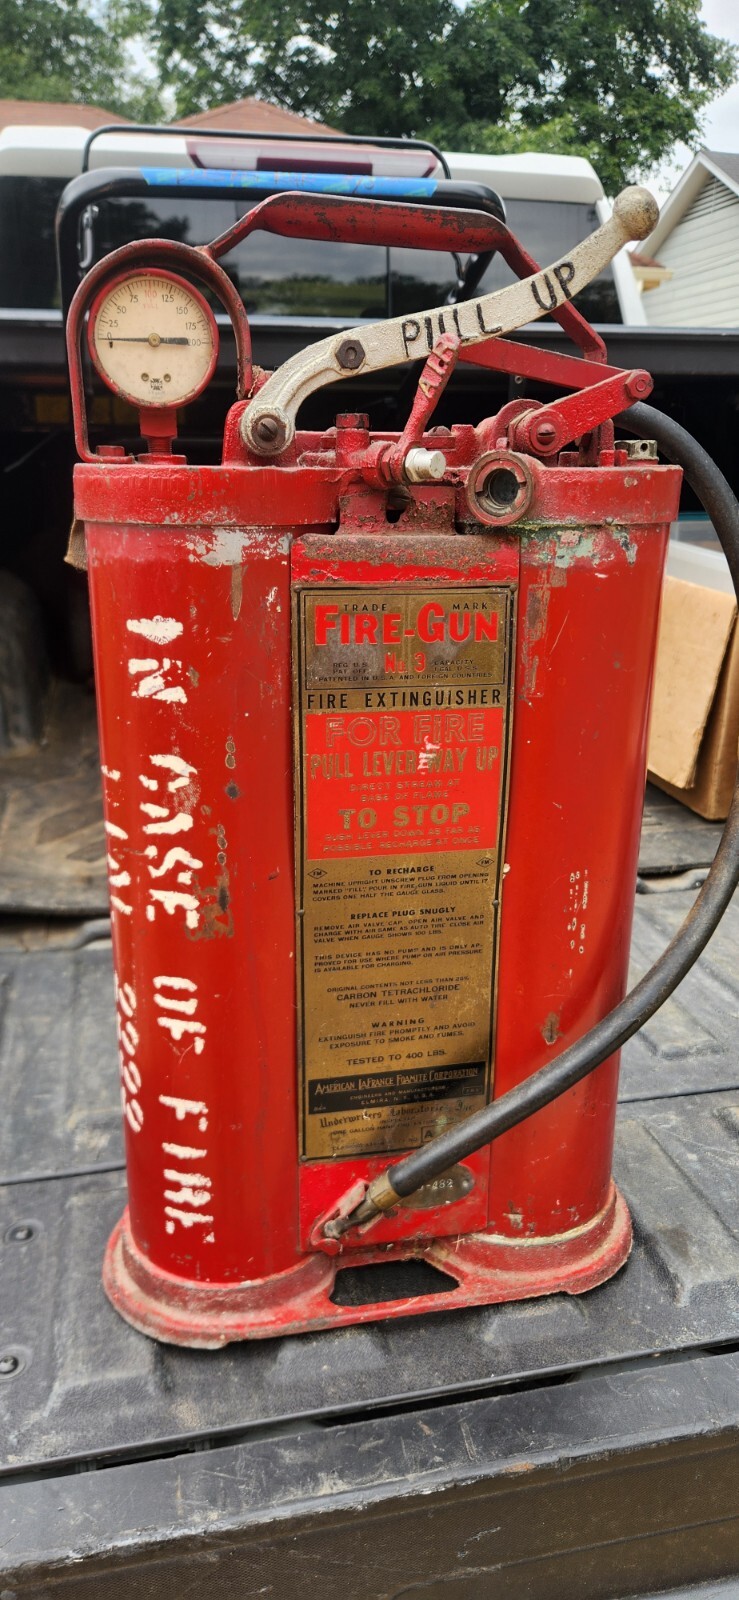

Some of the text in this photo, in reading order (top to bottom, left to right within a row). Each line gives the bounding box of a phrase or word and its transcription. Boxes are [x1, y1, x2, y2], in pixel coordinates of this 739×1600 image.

[130, 294, 138, 303] 75
[144, 290, 158, 298] 100
[162, 294, 174, 303] 125
[116, 306, 126, 314] 50
[176, 306, 188, 314] 150
[402, 262, 575, 358] PULL UP
[108, 320, 118, 328] 25
[186, 322, 196, 330] 175
[419, 337, 456, 398] AIR
[344, 602, 488, 612] TRADE MARK
[314, 602, 499, 646] FIRE-GUN
[414, 652, 426, 672] 3
[307, 688, 501, 710] FIRE EXTINGUISHER
[326, 713, 486, 748] FOR FIRE
[310, 753, 354, 780] PULL
[363, 750, 416, 777] LEVER
[476, 746, 498, 771] UP
[350, 778, 460, 792] DIRECT STREAM AT
[360, 790, 449, 802] BASE OF FLAME
[338, 802, 470, 830] TO STOP
[325, 833, 353, 842] PUSH
[358, 831, 388, 840] LEVER
[394, 829, 424, 838] DOWN
[446, 826, 464, 834] FAR
[468, 826, 480, 834] AS
[323, 836, 480, 852] POSSIBLE RECHARGE AT ONCE
[369, 865, 435, 876] TO RECHARGE
[350, 912, 389, 920] REPLACE
[420, 906, 456, 914] SNUGLY
[126, 615, 214, 1243] IN CASE OF FIRE
[324, 964, 360, 972] AVAILABLE
[336, 983, 461, 1001] CARBON TETRACHLORIDE
[360, 982, 398, 990] CONTENTS
[349, 1000, 376, 1008] NEVER
[420, 994, 448, 1002] WATER
[371, 1017, 426, 1029] WARNING
[318, 1032, 368, 1043] EXTINGUISH
[389, 1025, 431, 1036] PROMPTLY
[452, 1021, 477, 1029] AVOID
[329, 1040, 372, 1050] EXPOSURE
[388, 1034, 416, 1044] SMOKE
[436, 1030, 465, 1038] FUMES.
[346, 1048, 448, 1066] TESTED TO 400 LBS.
[314, 1067, 480, 1096] AMERICAN FOAMITE CORPORATION
